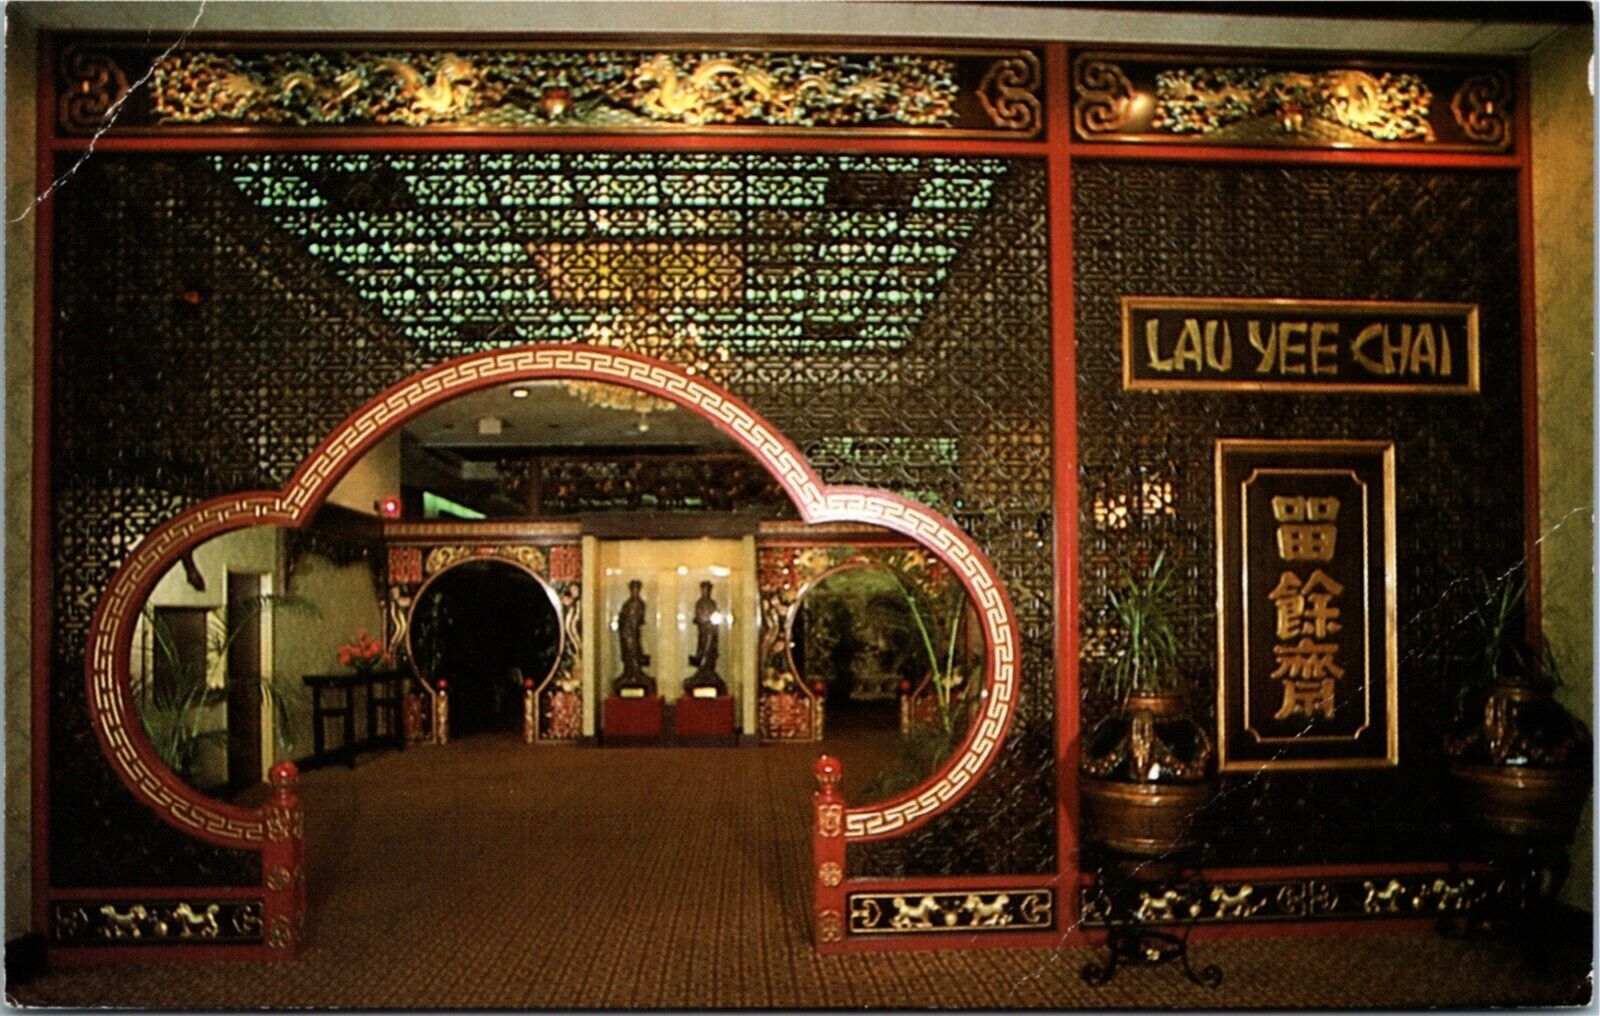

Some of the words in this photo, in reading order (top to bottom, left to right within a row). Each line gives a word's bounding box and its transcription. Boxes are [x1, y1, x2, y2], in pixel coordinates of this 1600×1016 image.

[1146, 318, 1232, 372] LAU
[1247, 320, 1340, 375] YEE
[1352, 322, 1452, 376] CHAI
